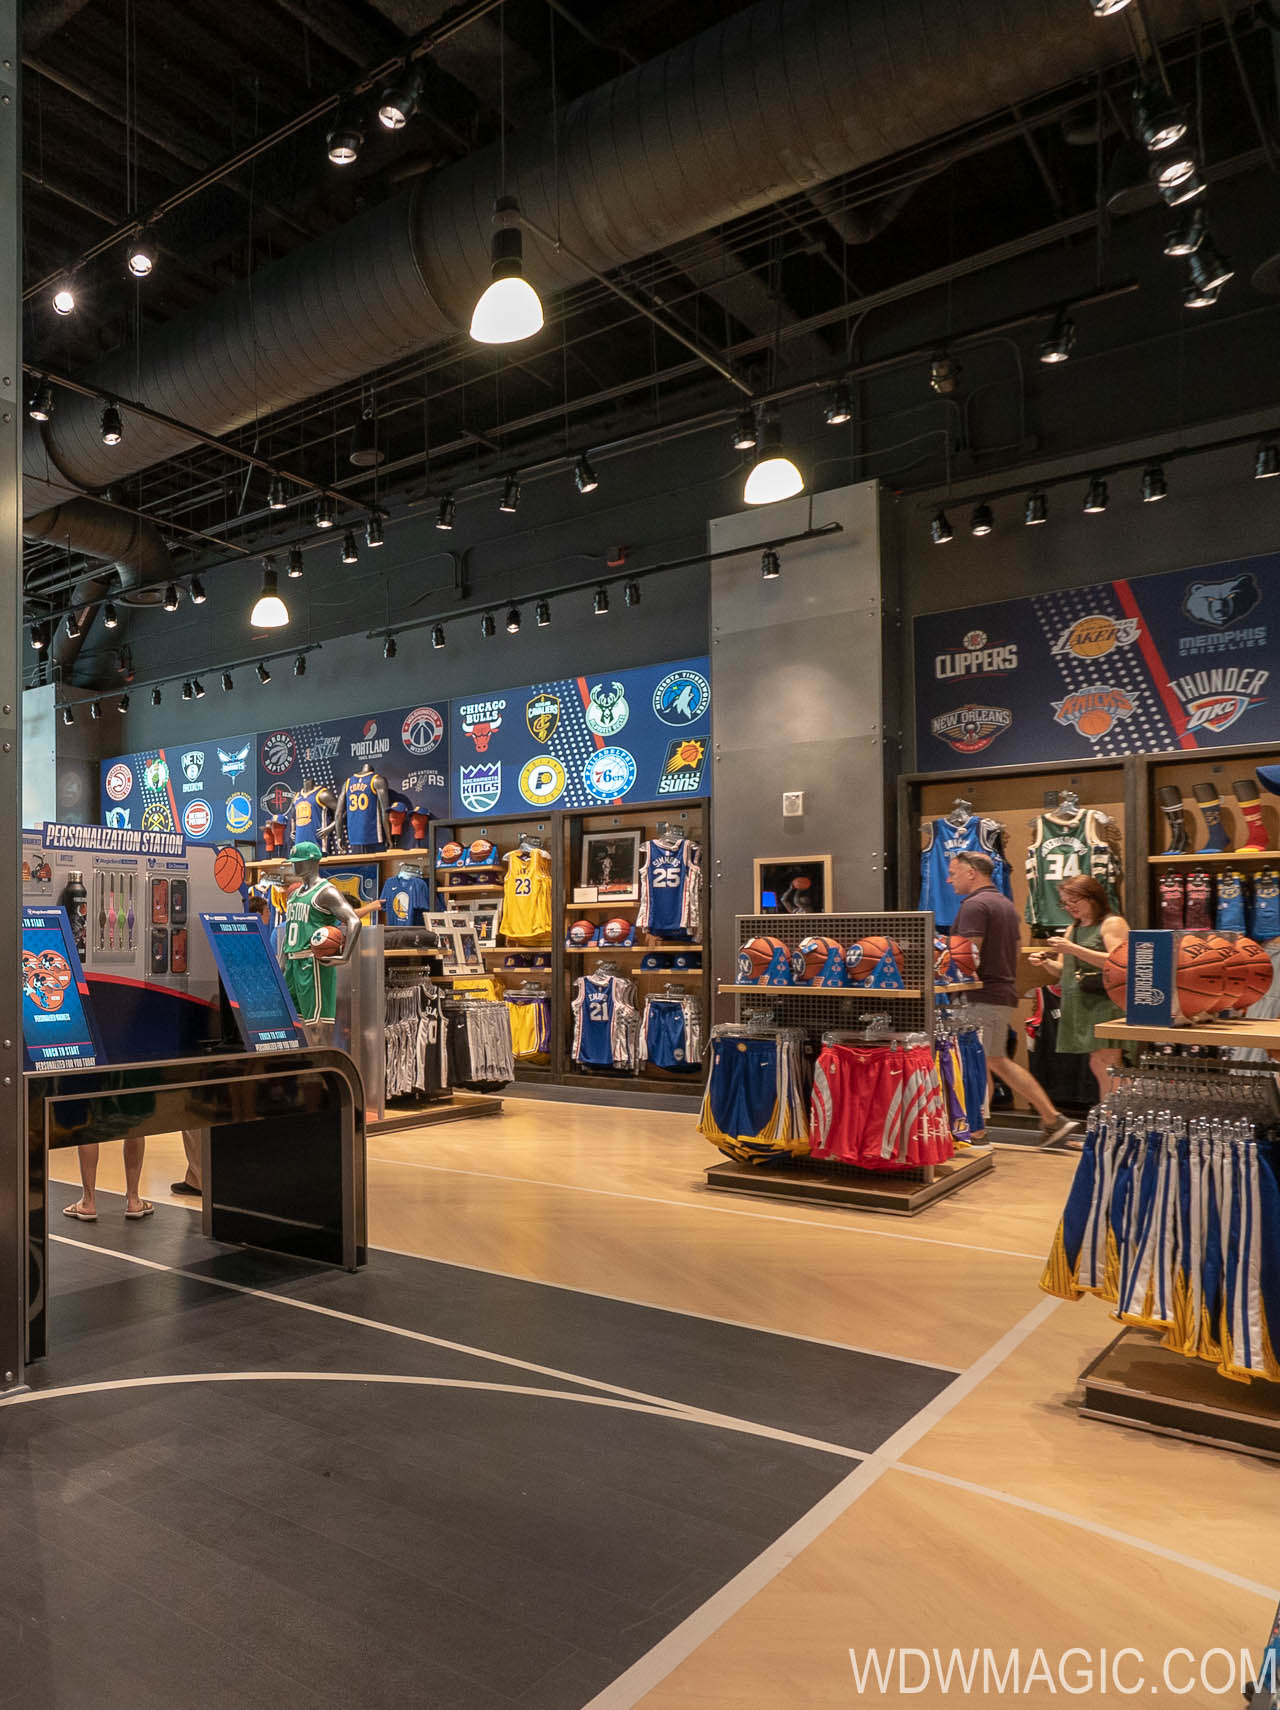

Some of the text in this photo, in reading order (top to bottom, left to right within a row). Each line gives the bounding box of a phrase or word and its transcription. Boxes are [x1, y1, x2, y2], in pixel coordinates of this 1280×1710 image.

[1178, 626, 1267, 650] MEMPHIS
[935, 644, 1018, 679] CLIPPERS
[1167, 667, 1270, 702] THUNDER
[460, 699, 506, 716] CHICAGO
[466, 710, 498, 724] BULLS
[1187, 700, 1236, 729] OKC
[934, 710, 1010, 732] NEW ORLEANS
[264, 734, 292, 751] TORONTO
[351, 738, 390, 757] PORTLAND
[182, 753, 203, 765] NETS
[264, 756, 293, 773] RAPTORS
[586, 747, 634, 776] PHILADELPHIA
[594, 769, 625, 783] 76ers
[462, 783, 499, 794] KINGS
[349, 793, 369, 812] 30
[46, 824, 184, 855] PERSONALIZATION STATION
[1045, 853, 1081, 880] 34
[514, 878, 532, 896] 23
[652, 867, 681, 888] 25
[286, 902, 310, 924] OSTON
[287, 922, 299, 947] 0
[1134, 948, 1154, 1006] NBA EXPERIENCE
[589, 1001, 609, 1021] 21
